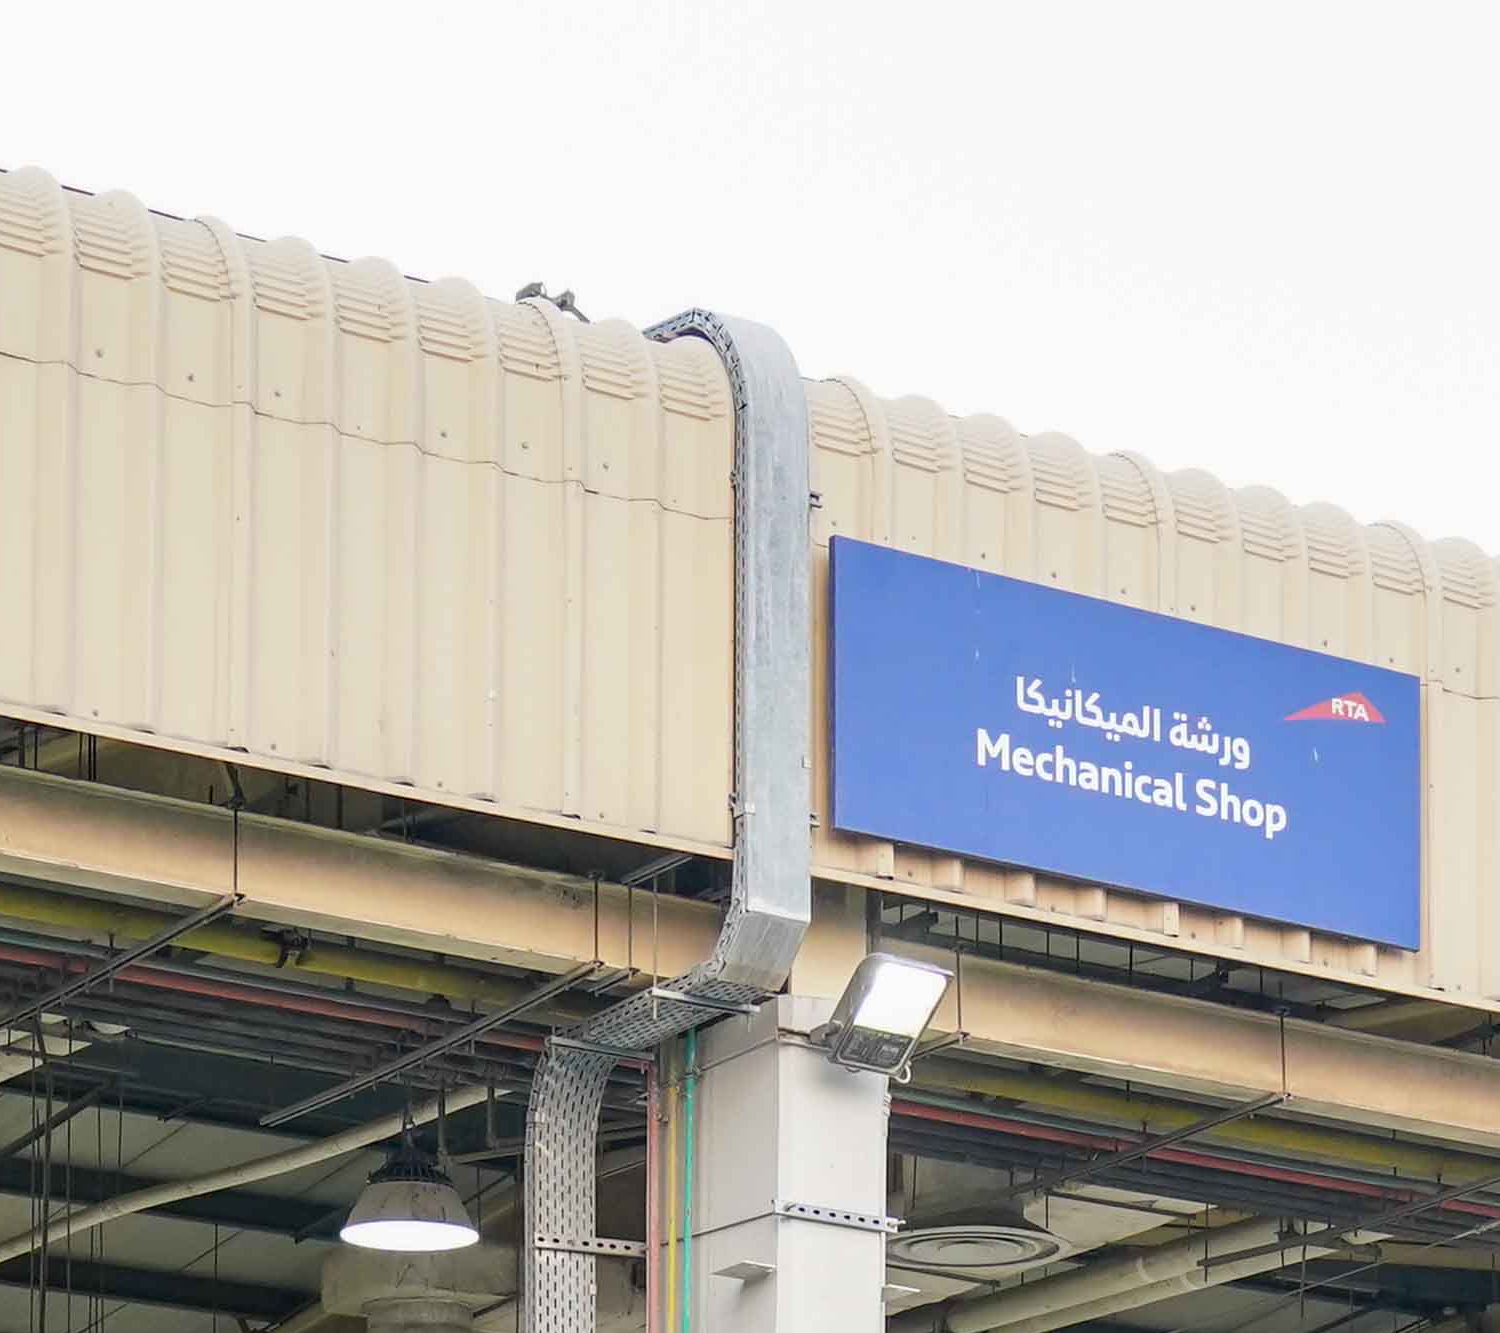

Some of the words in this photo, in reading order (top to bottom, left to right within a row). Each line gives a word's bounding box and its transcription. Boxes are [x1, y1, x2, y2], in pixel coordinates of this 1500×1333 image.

[1016, 676, 1162, 742] الميكانيكا
[1331, 697, 1370, 722] RTA
[1169, 711, 1251, 770] ورشة
[976, 728, 1188, 812] Mechanical
[1195, 778, 1287, 840] Shop
